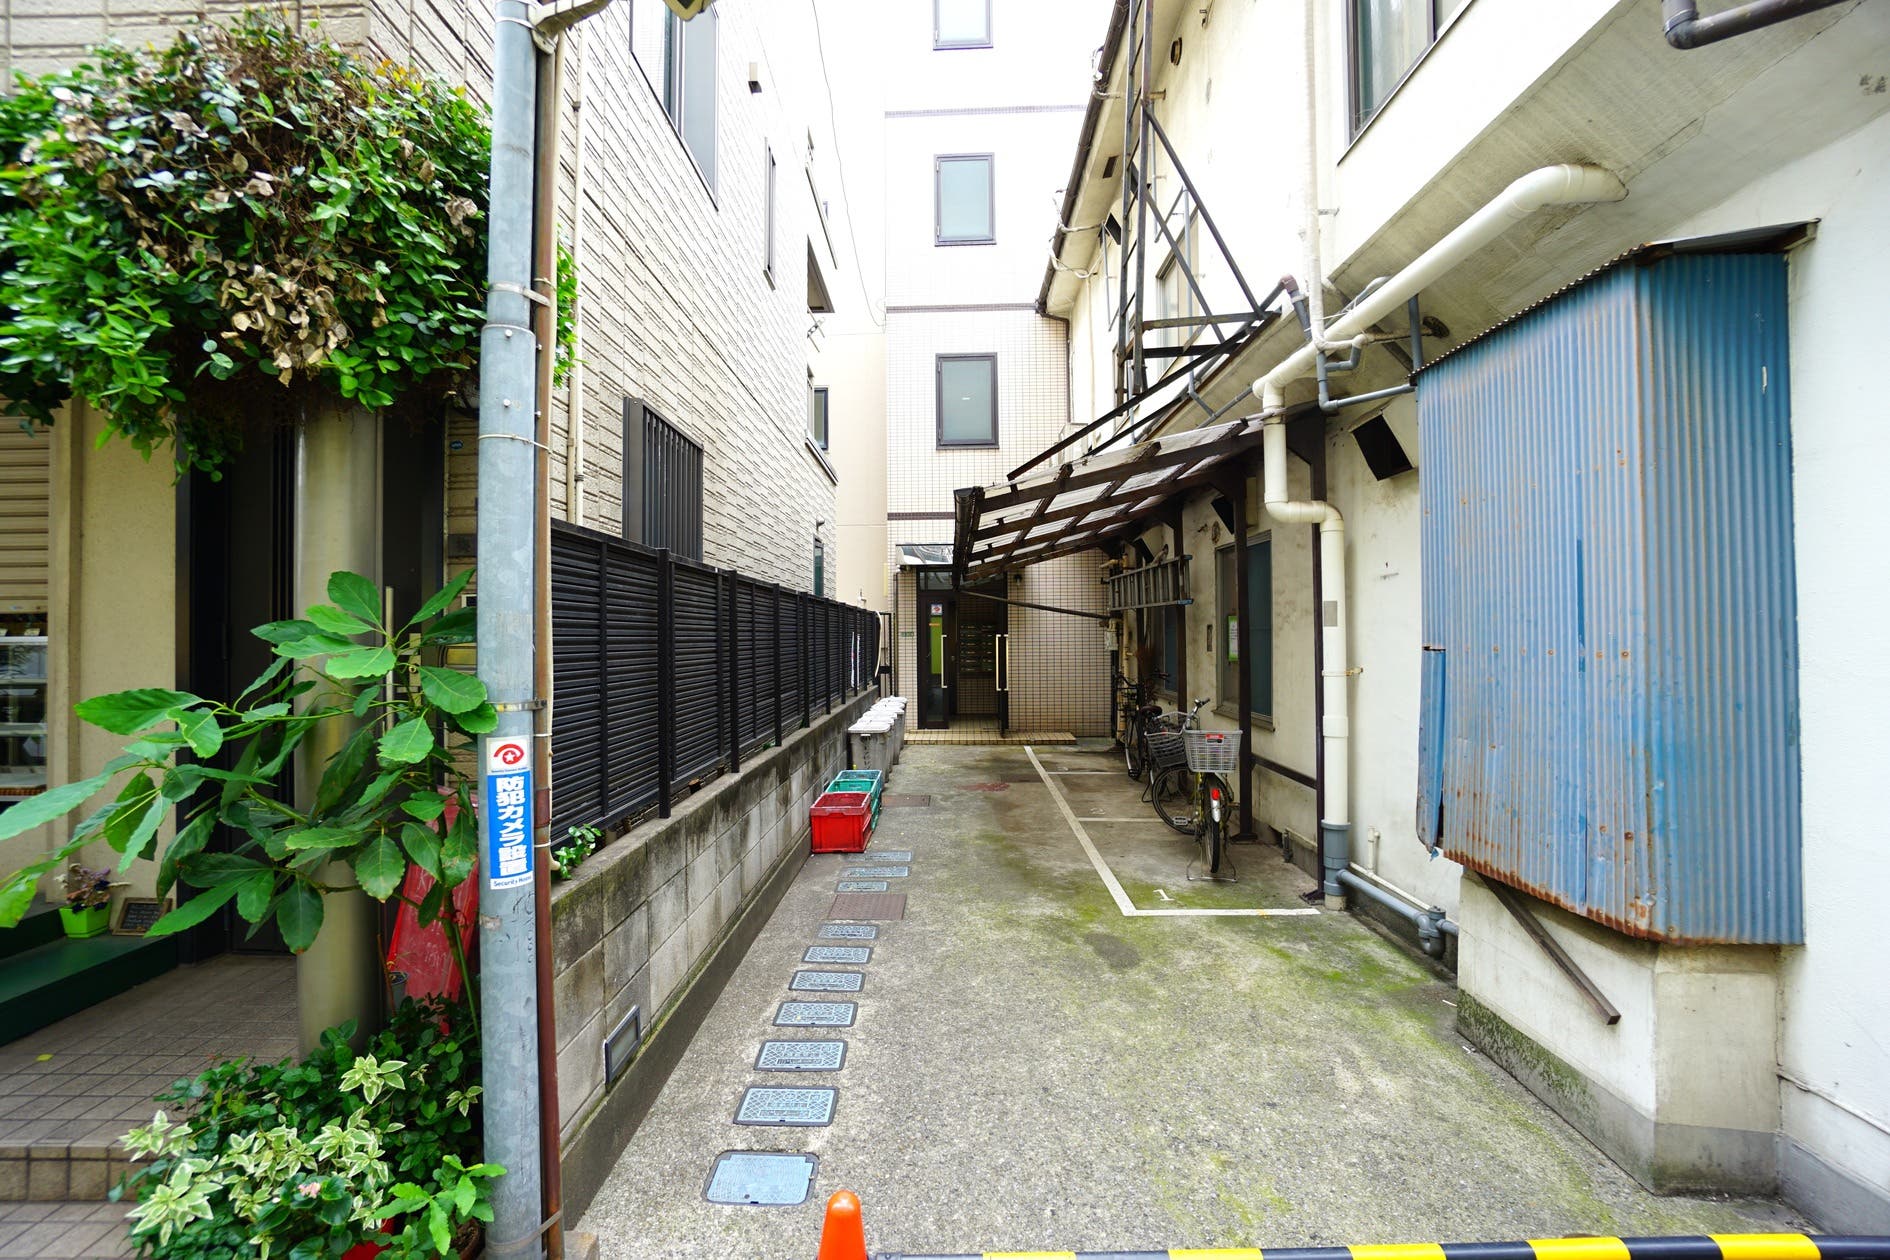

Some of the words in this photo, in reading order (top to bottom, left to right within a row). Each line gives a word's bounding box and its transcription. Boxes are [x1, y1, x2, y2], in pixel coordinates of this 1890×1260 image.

[496, 776, 527, 876] 防犯カメラ設置
[1153, 888, 1175, 901] 1
